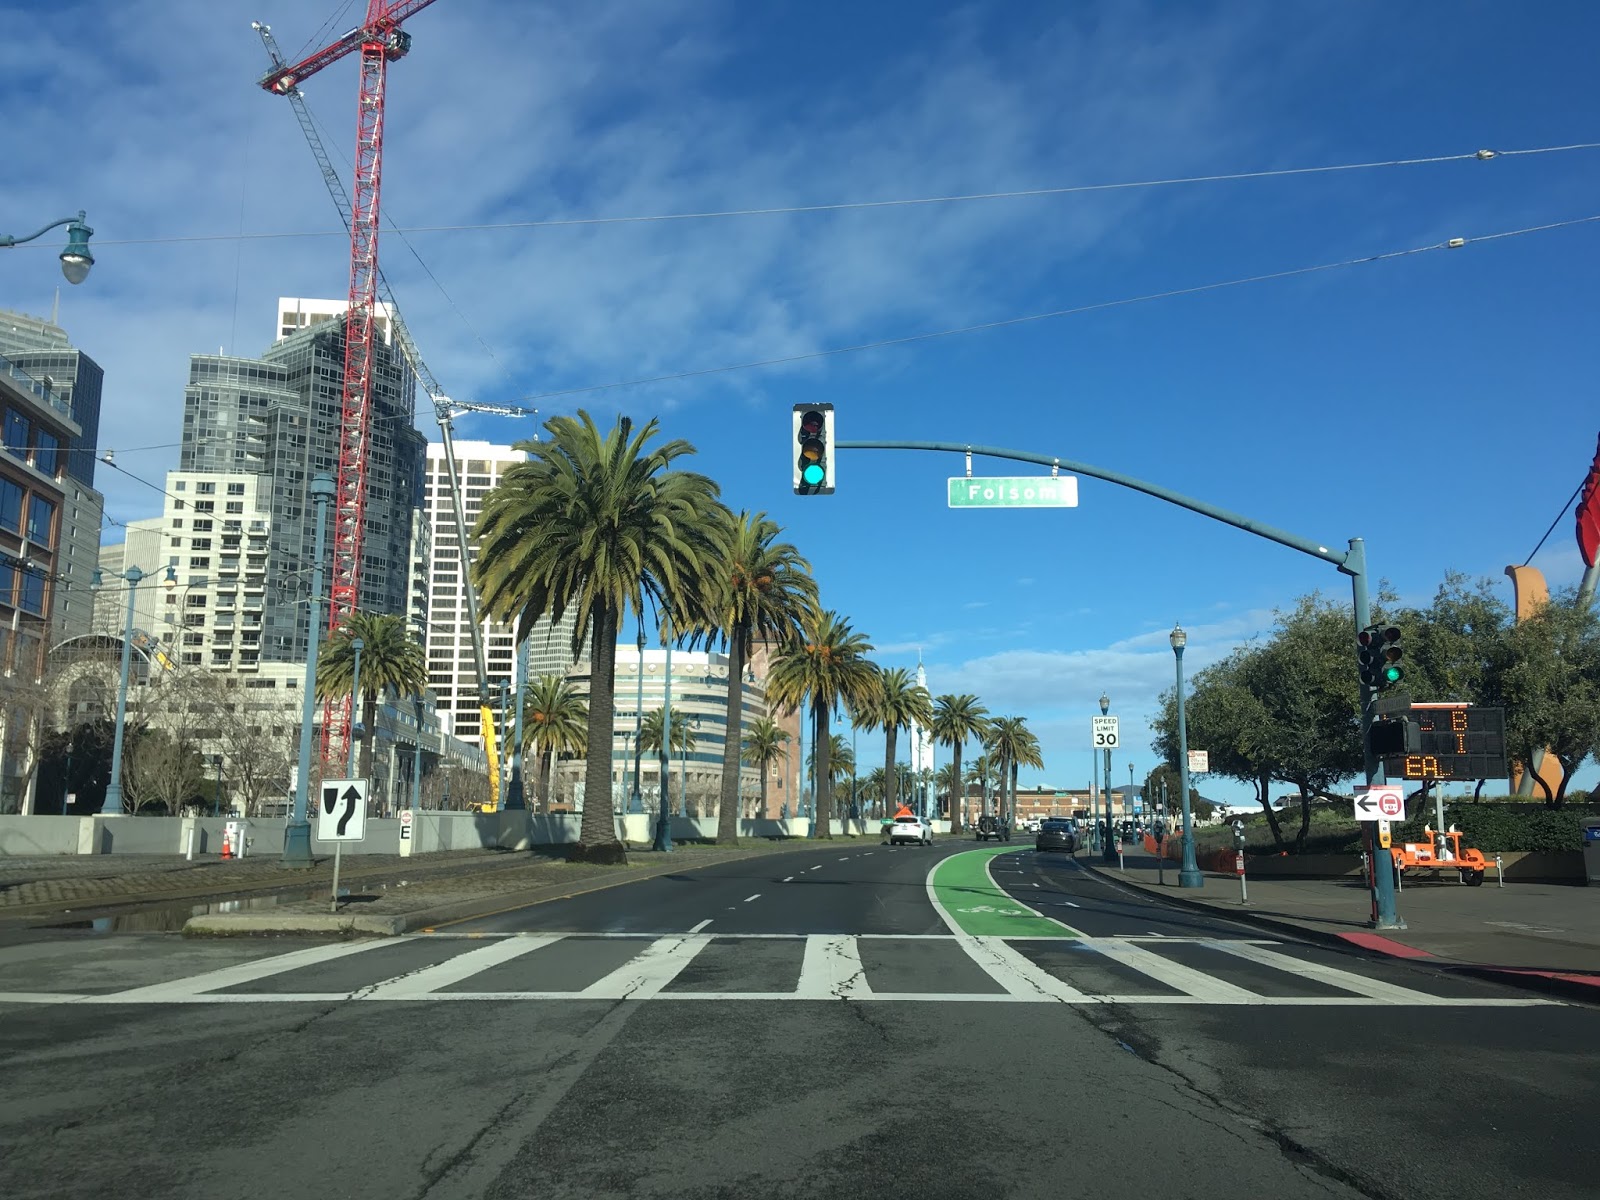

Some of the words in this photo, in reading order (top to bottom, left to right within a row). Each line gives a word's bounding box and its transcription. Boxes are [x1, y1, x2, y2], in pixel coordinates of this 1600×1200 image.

[969, 485, 1057, 501] Folsom
[1095, 733, 1117, 745] 30
[400, 825, 411, 840] E
